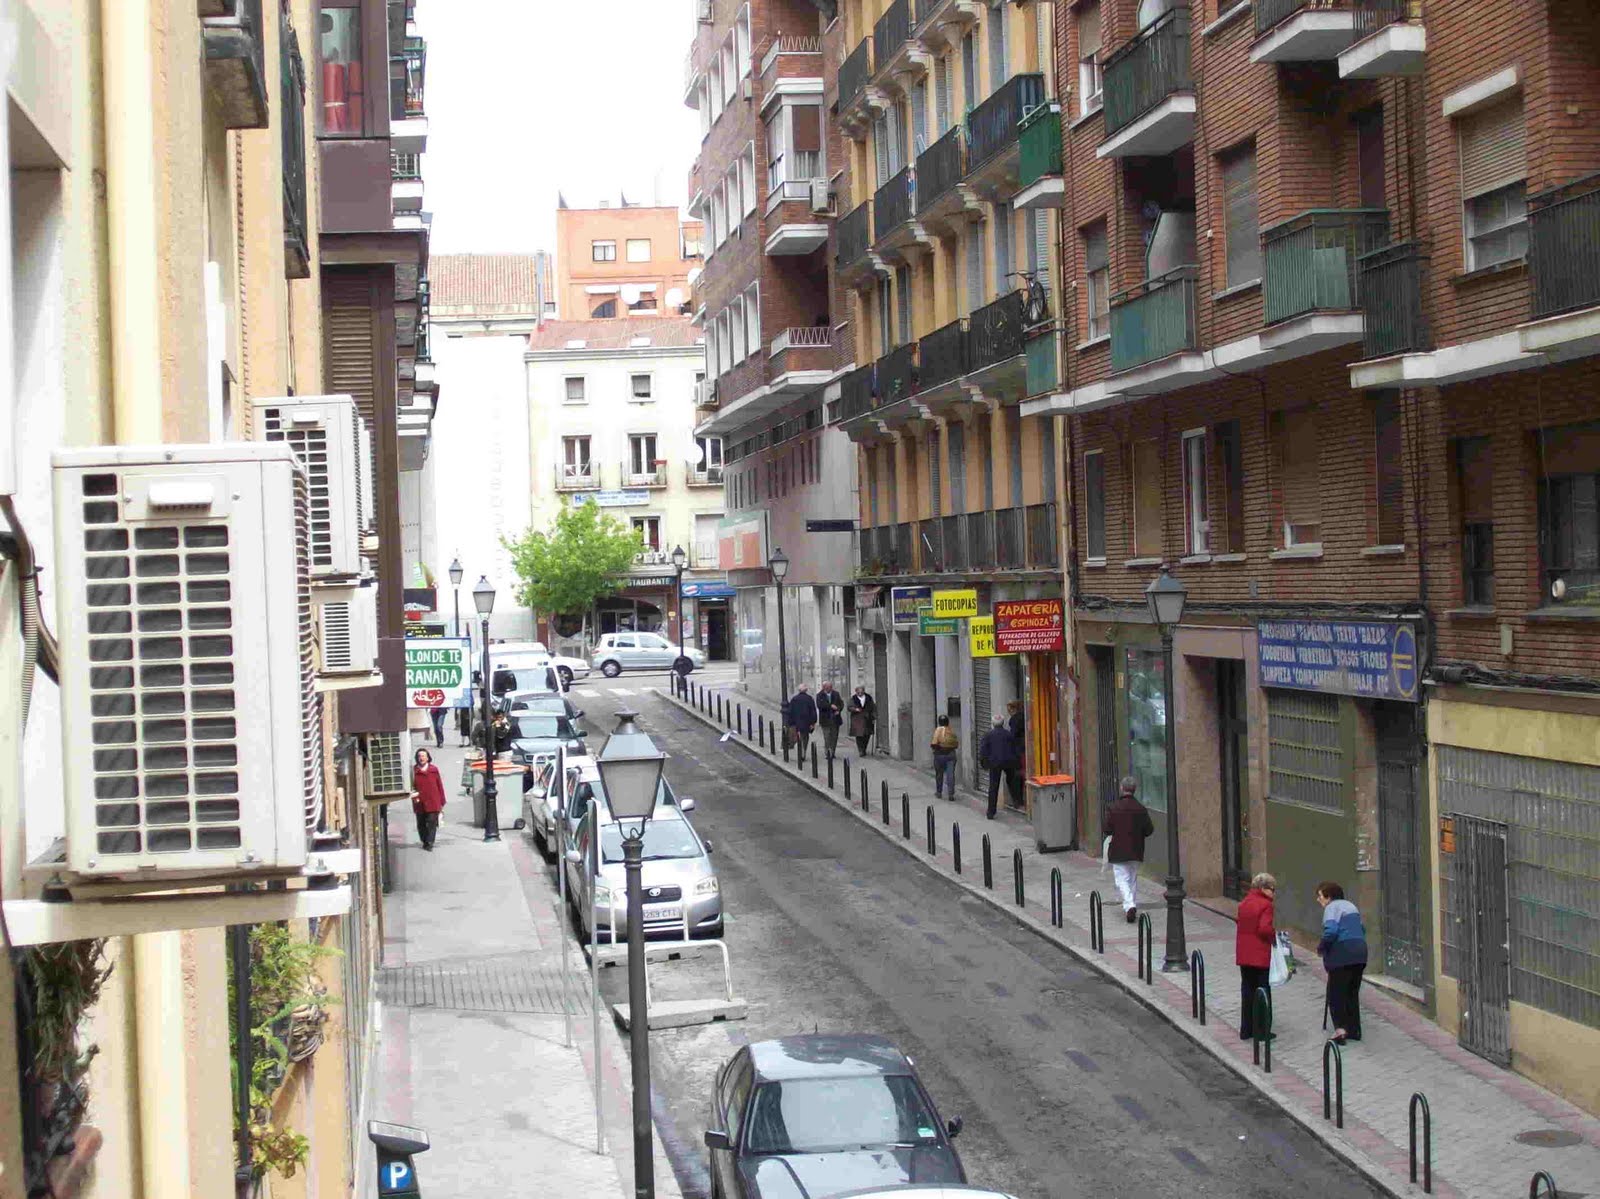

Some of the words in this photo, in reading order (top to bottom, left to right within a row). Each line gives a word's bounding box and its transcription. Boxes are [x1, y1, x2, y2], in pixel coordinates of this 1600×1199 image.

[936, 598, 977, 611] FOTOCOPIAS
[976, 640, 985, 650] DE
[406, 650, 431, 663] ALON
[432, 650, 446, 663] DE
[448, 649, 460, 663] TE
[406, 669, 459, 685] RANADA
[390, 1161, 408, 1189] P
